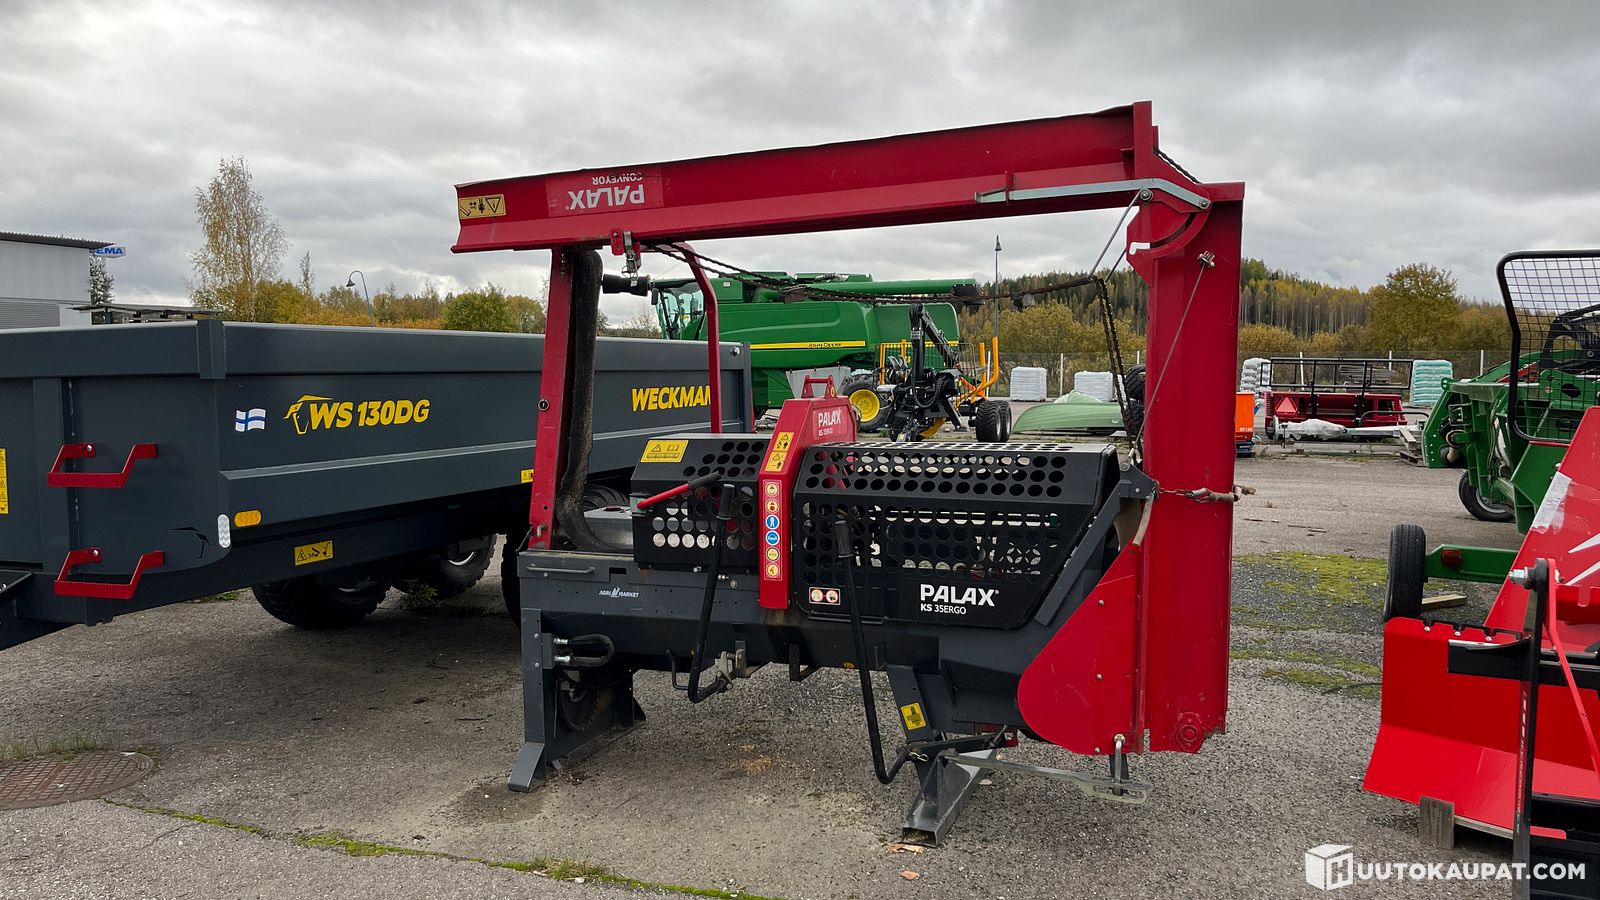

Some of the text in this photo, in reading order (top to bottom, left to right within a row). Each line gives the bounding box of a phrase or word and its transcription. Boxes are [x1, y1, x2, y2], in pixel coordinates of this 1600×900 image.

[591, 172, 643, 185] CONVEYOR
[567, 184, 645, 211] PALAX
[309, 399, 431, 430] WS 130DG
[817, 409, 842, 427] PALAX
[920, 583, 996, 607] PALAX
[920, 603, 967, 615] KS 35ERGO
